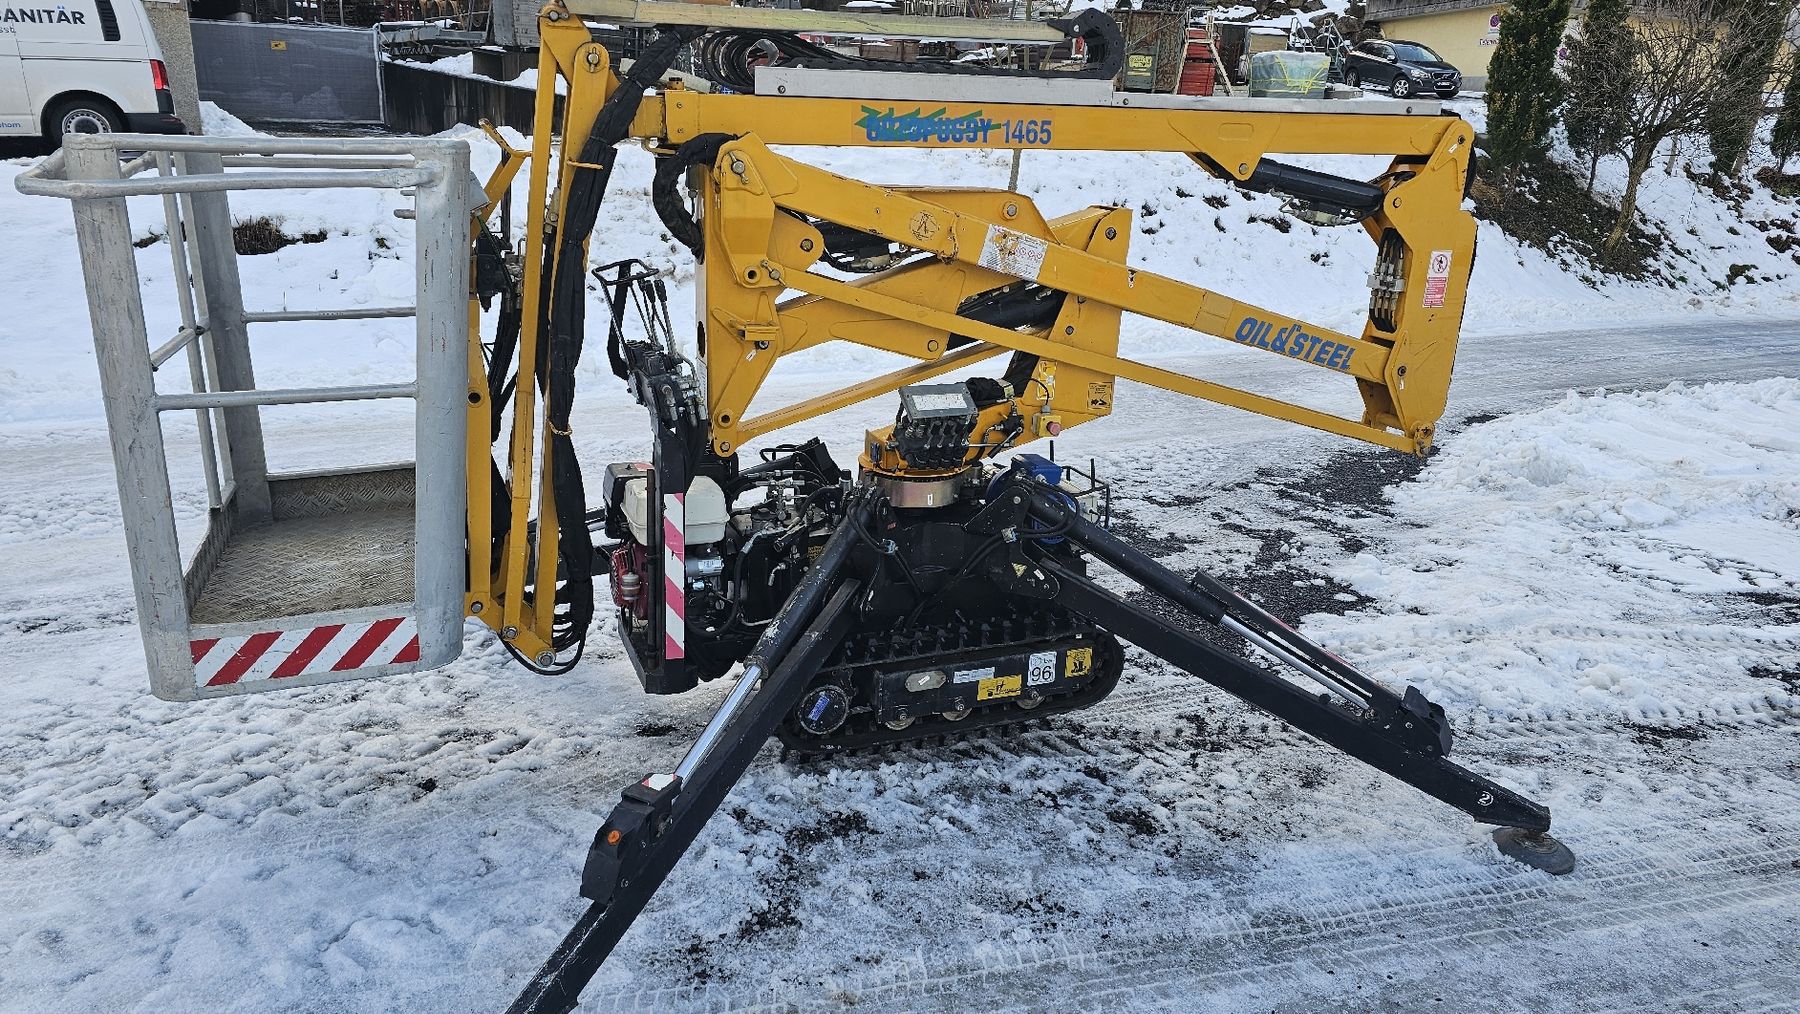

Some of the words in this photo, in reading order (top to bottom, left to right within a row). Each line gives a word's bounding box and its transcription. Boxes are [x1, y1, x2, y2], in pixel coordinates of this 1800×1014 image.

[0, 5, 86, 25] ANITÄR
[1002, 119, 1052, 145] 1465
[1031, 665, 1052, 682] 96
